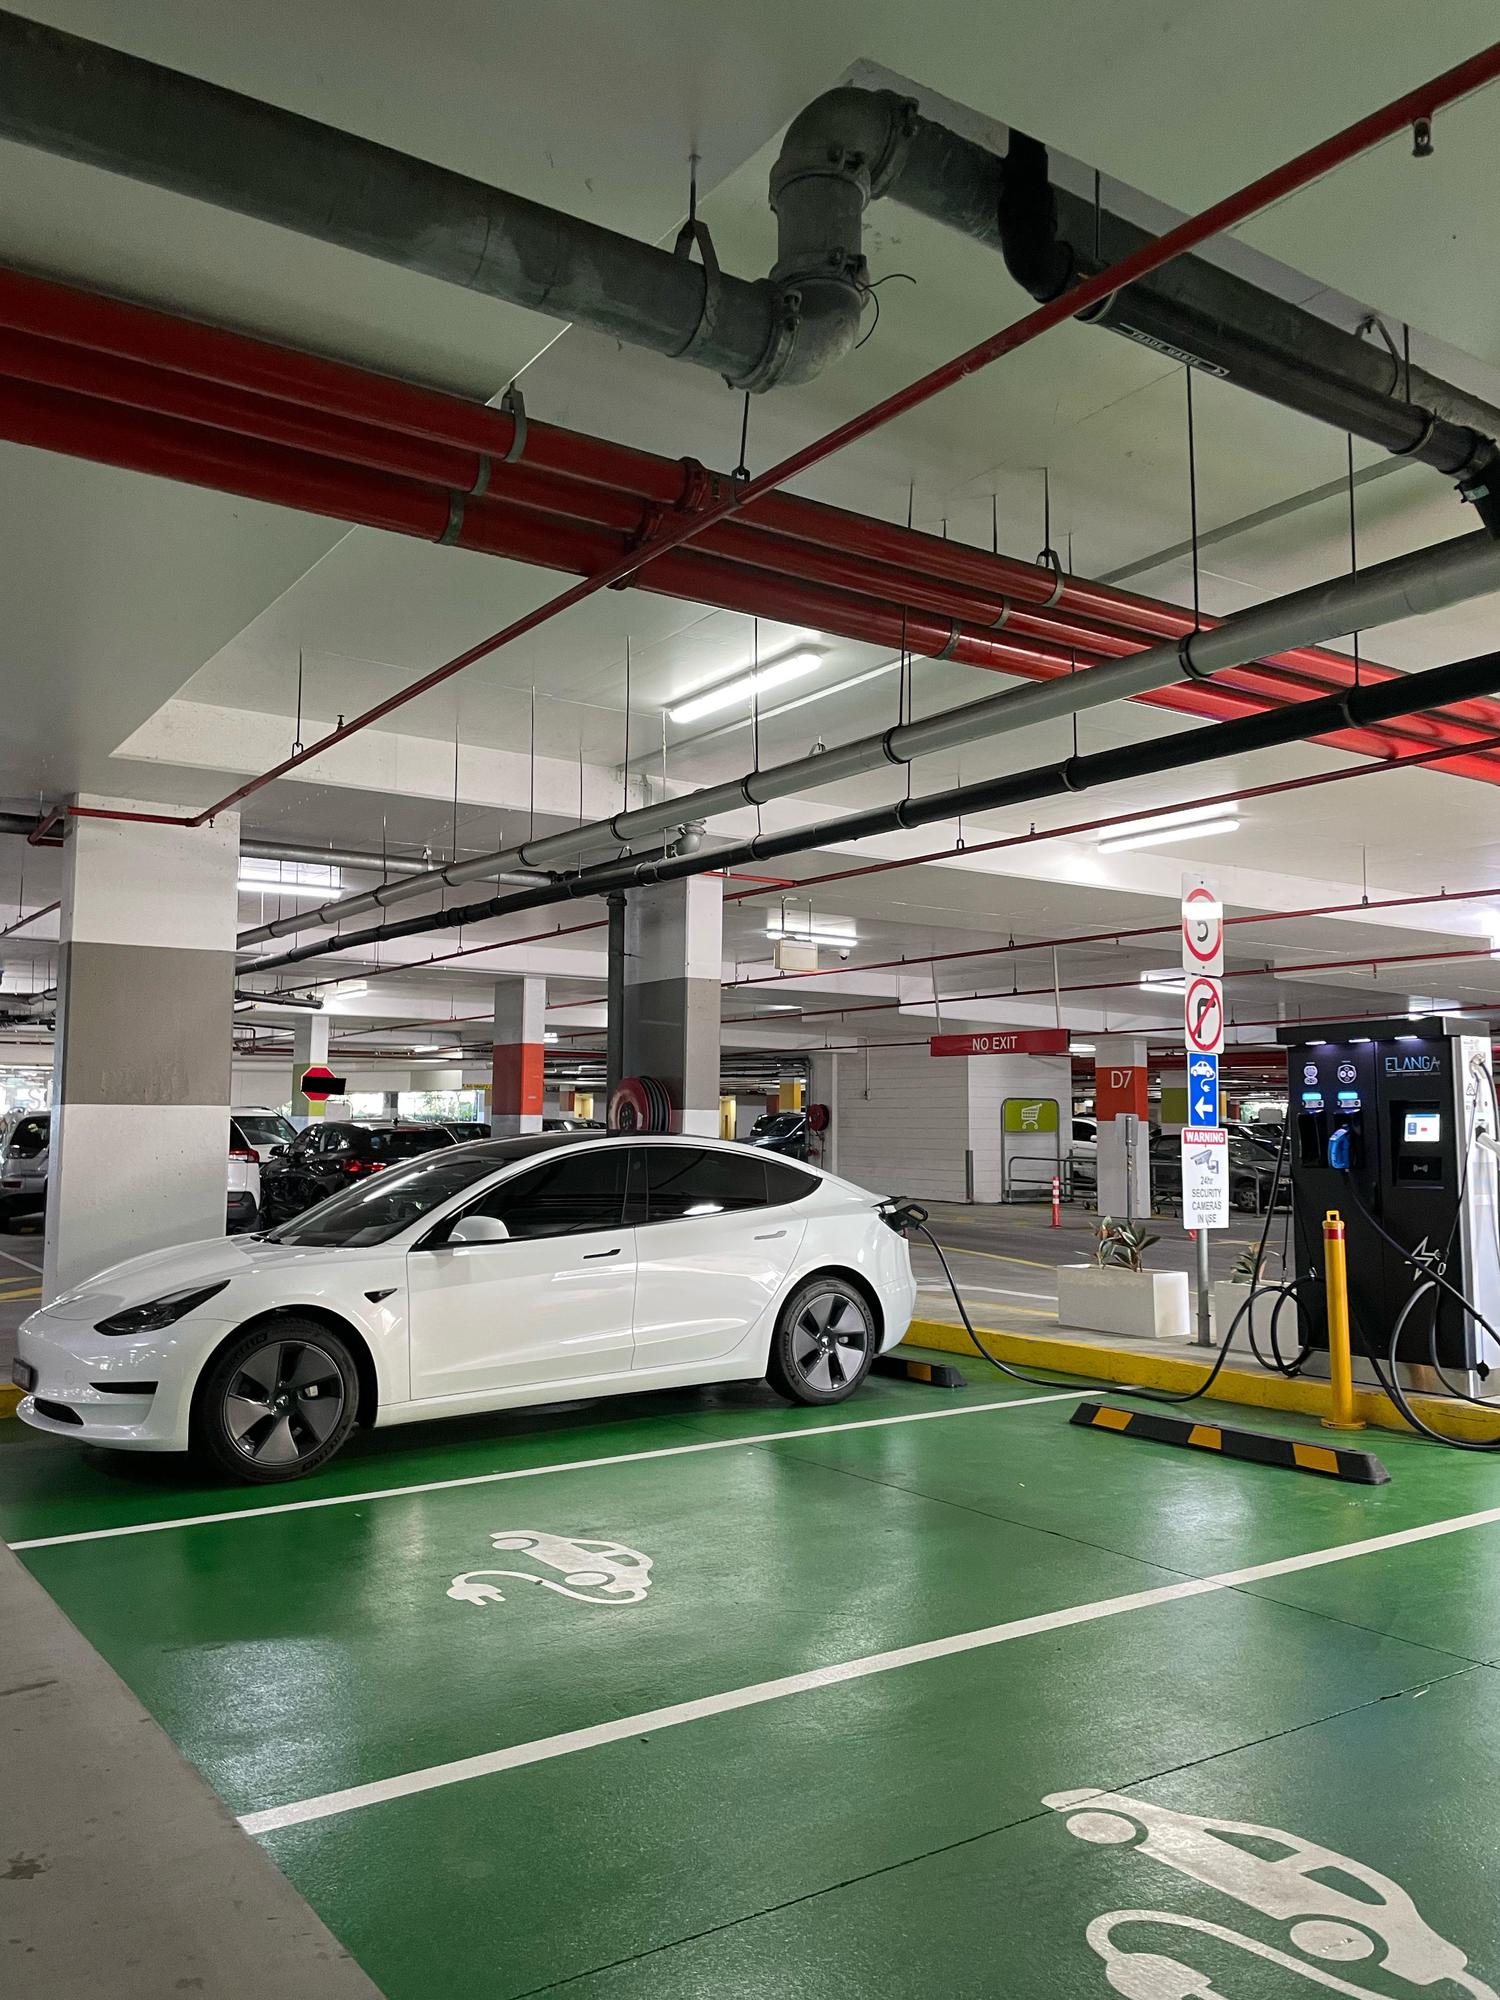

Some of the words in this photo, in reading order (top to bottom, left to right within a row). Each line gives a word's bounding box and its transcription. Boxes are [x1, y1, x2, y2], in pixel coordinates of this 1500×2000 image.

[972, 1037, 989, 1051] NO
[992, 1036, 1018, 1050] EXIT
[1385, 1056, 1440, 1072] ELANGA
[1111, 1070, 1132, 1089] D7
[1185, 1131, 1224, 1143] WARNING
[1200, 1175, 1214, 1185] 24hr
[1191, 1188, 1221, 1198] SECURITY
[1191, 1201, 1222, 1211] CAMERAS
[1197, 1214, 1204, 1224] IN
